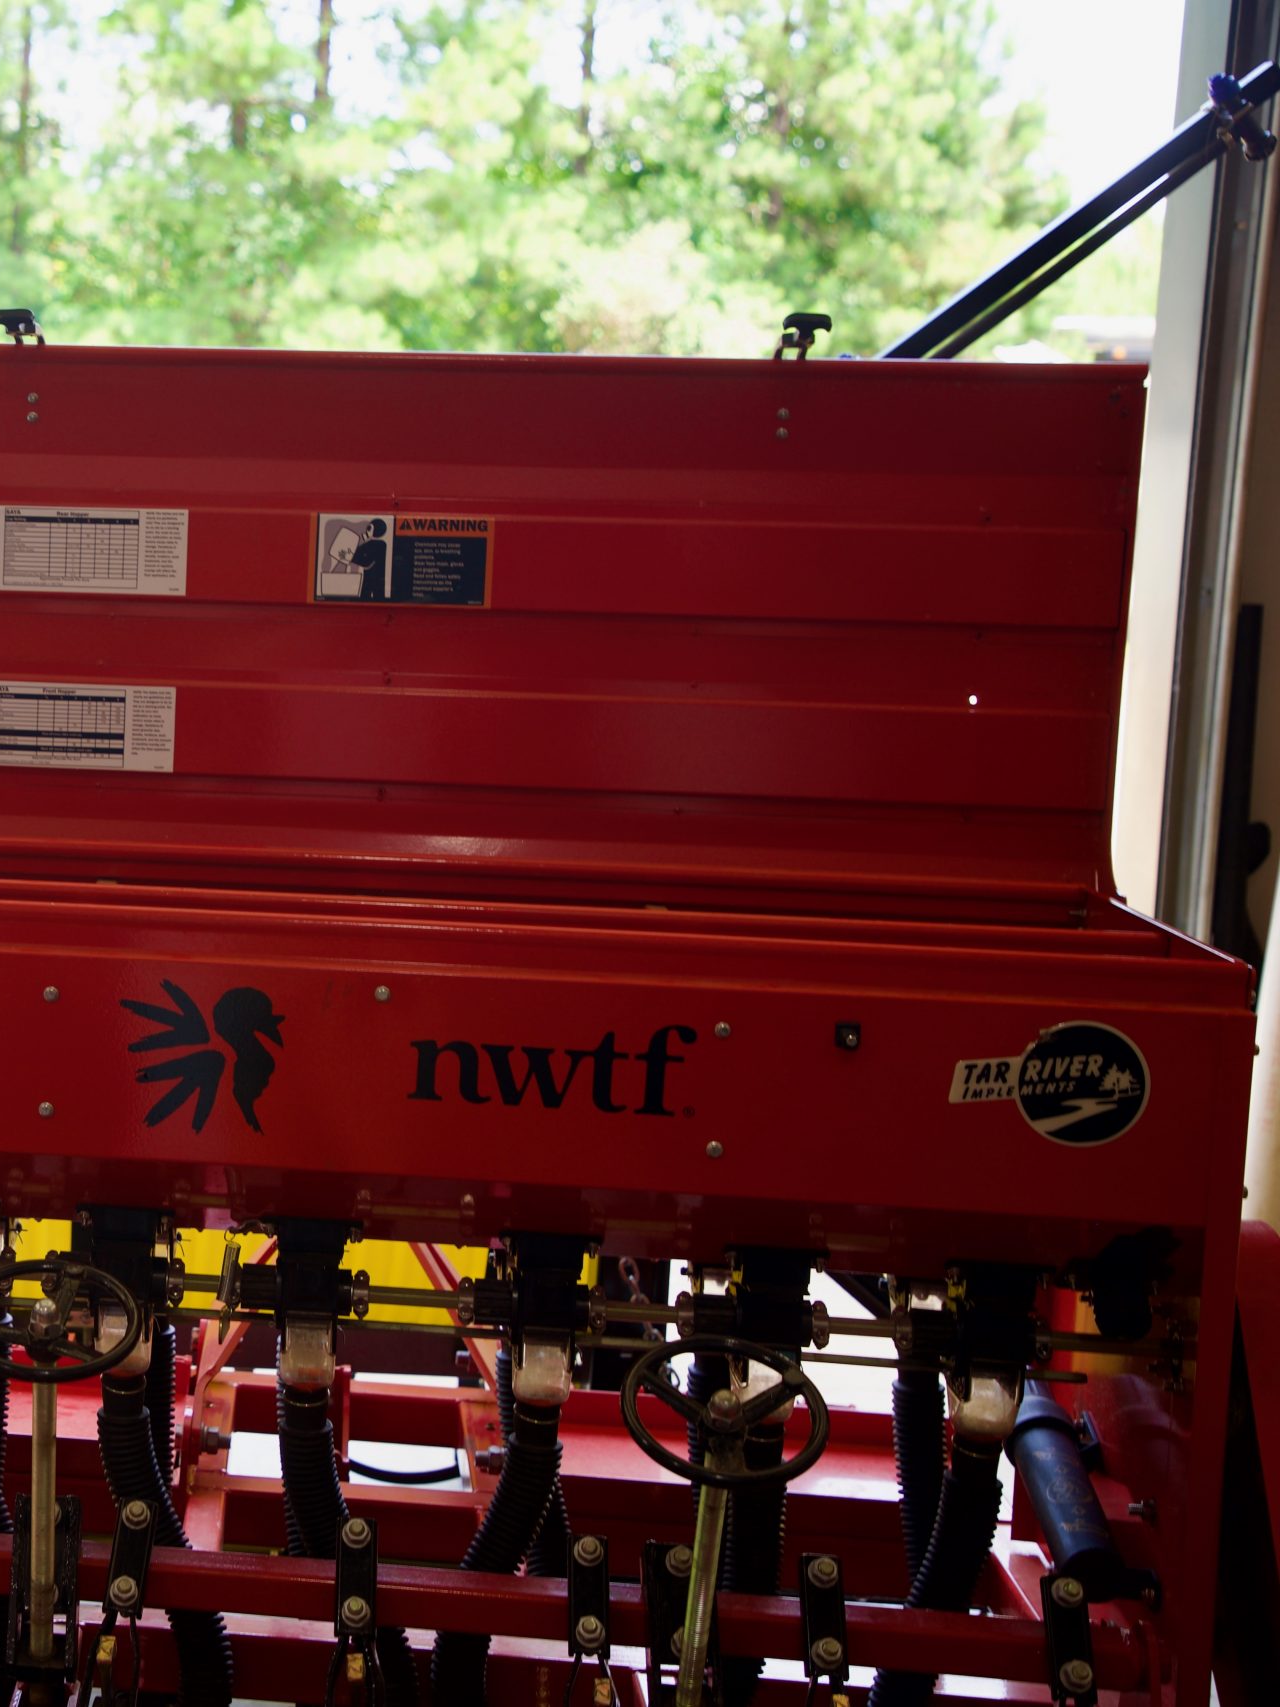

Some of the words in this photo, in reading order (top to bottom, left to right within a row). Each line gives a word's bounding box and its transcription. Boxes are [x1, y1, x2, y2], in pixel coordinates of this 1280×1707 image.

[413, 518, 488, 532] WARNING
[407, 1024, 698, 1117] nwtf
[964, 1061, 1011, 1085] TAR
[1024, 1054, 1104, 1082] RIVER
